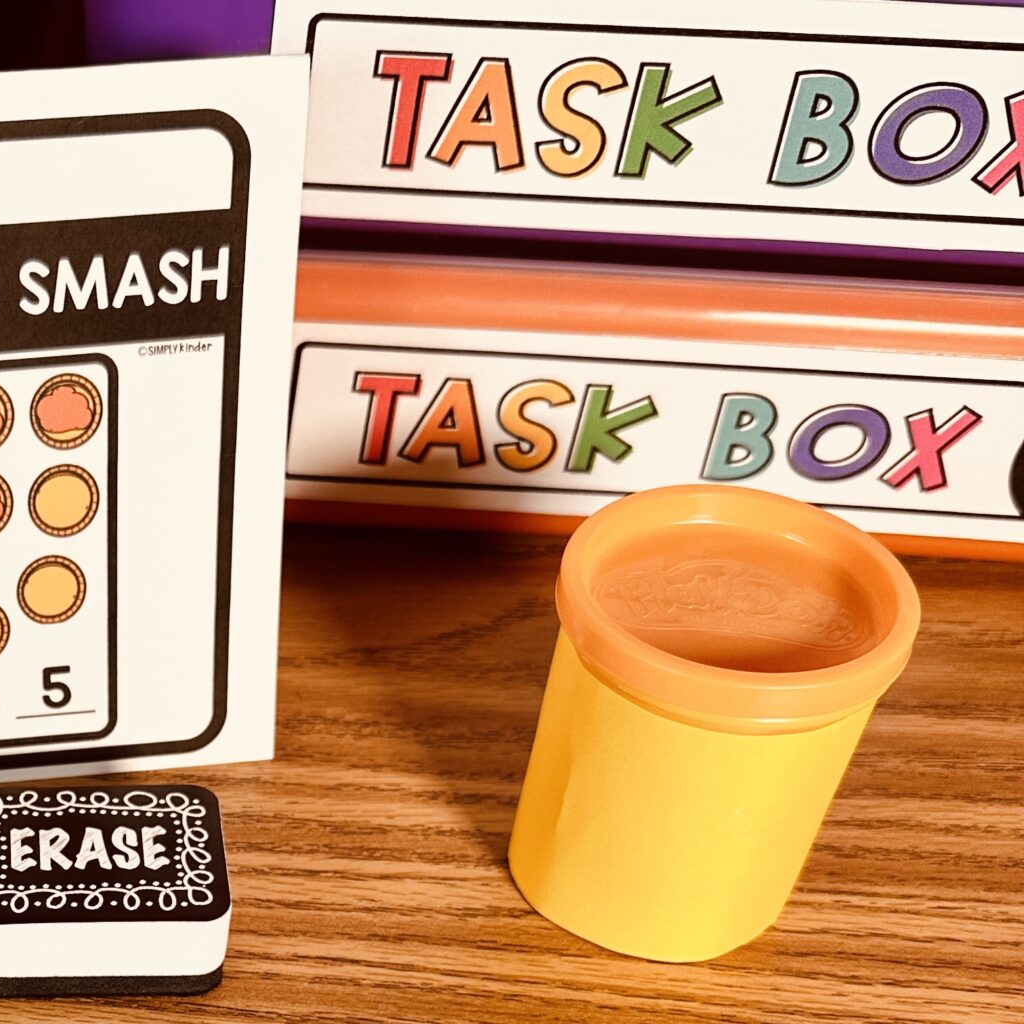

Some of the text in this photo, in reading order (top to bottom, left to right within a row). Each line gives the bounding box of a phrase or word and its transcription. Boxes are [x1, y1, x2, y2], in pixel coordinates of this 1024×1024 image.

[373, 49, 723, 178] TASK
[18, 245, 231, 316] SMASH
[353, 370, 983, 494] TASK BOX
[42, 665, 72, 709] 5
[9, 826, 171, 872] ERASE
